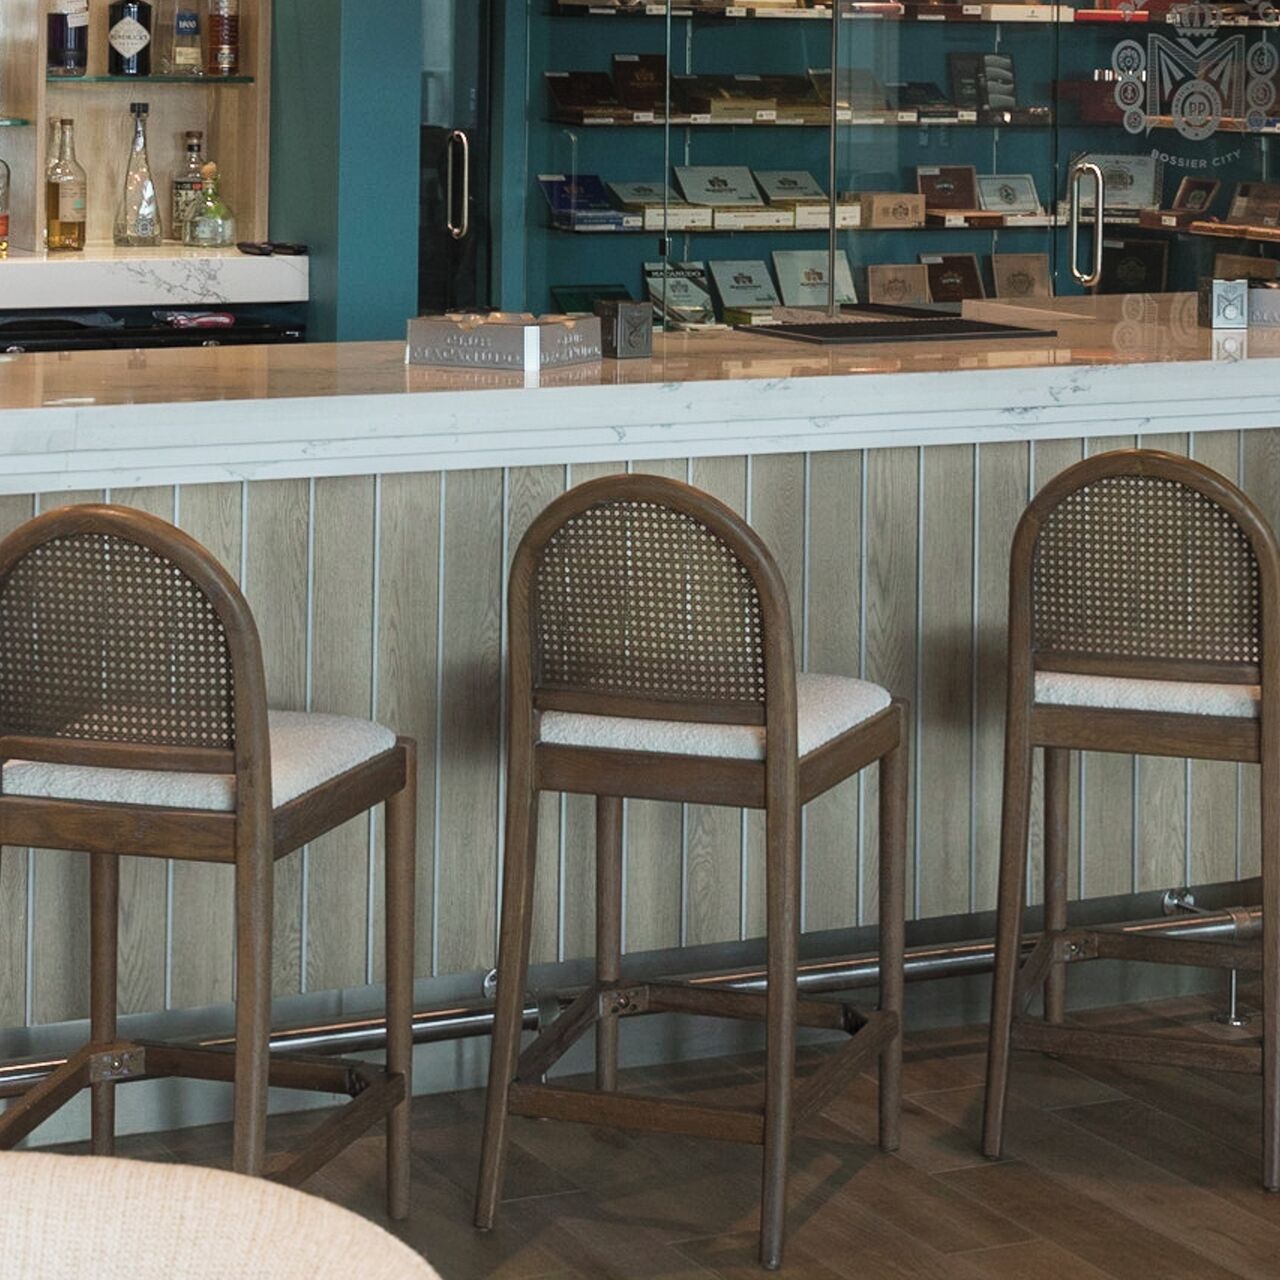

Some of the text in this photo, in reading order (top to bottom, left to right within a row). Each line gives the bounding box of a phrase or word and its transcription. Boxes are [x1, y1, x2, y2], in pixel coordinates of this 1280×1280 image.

[178, 20, 197, 29] 1800
[1150, 149, 1242, 169] BOSSIER CITY
